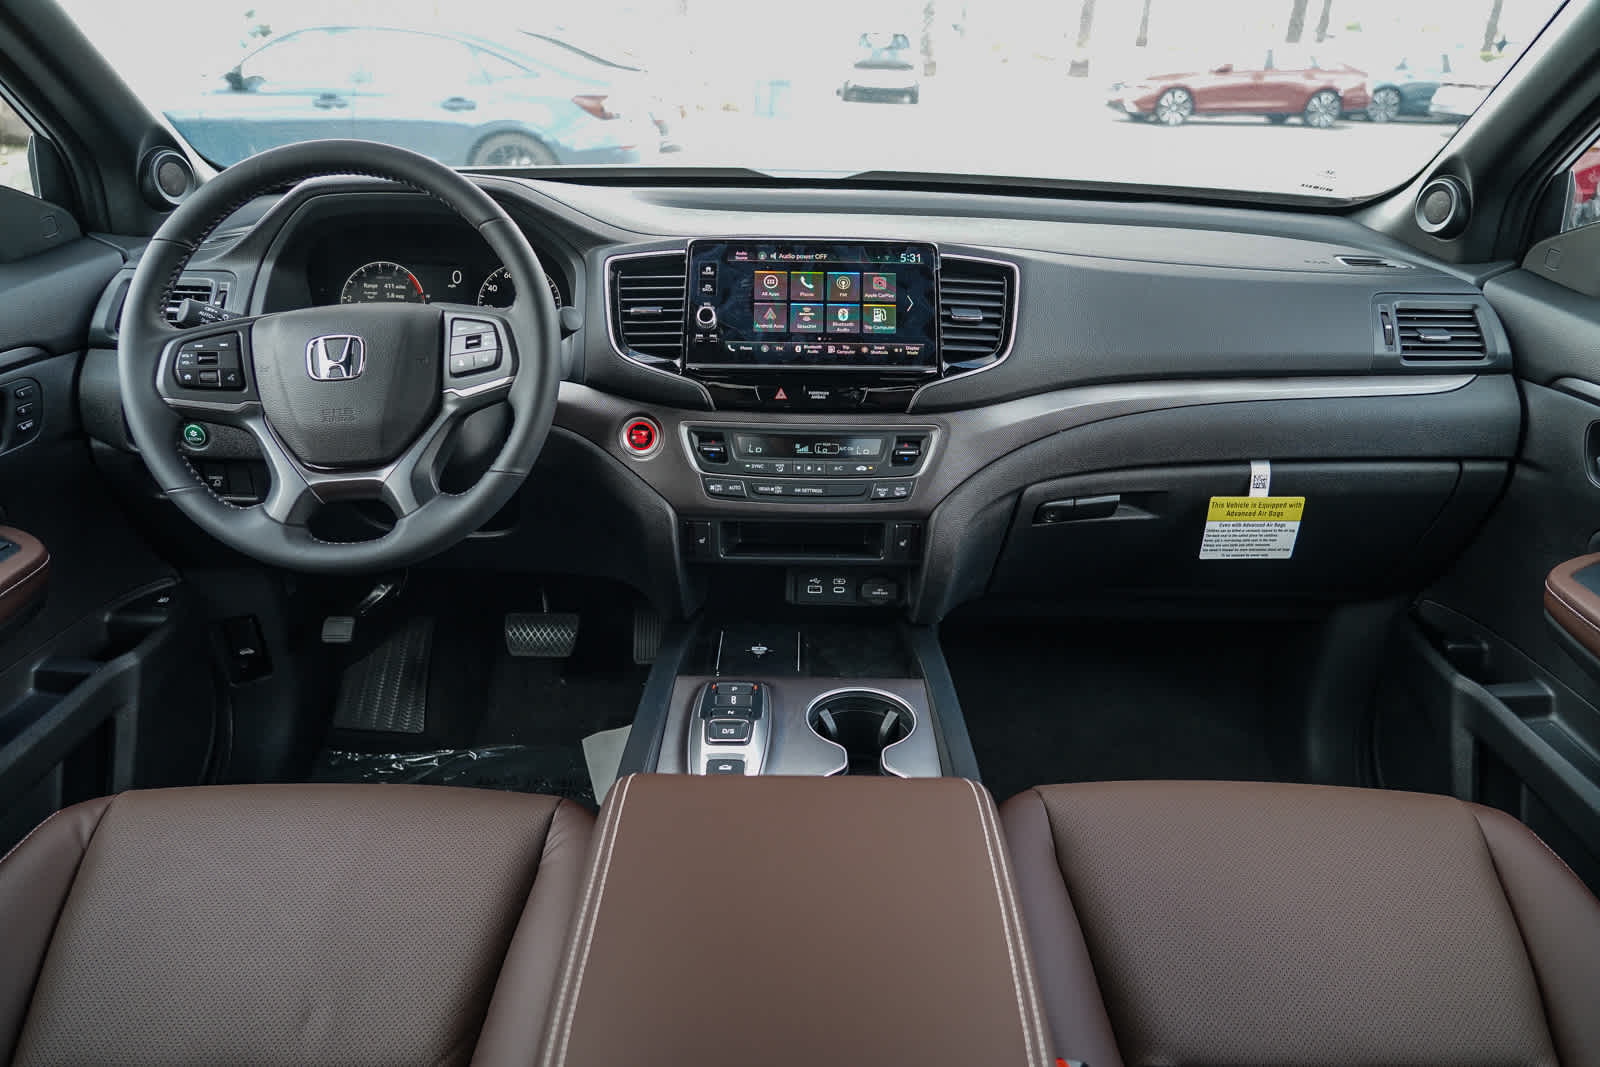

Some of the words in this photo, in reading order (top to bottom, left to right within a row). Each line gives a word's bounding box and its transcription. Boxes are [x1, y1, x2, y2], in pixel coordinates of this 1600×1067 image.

[900, 253, 921, 263] 5:31
[452, 270, 462, 284] 0
[748, 444, 762, 453] Lo
[856, 446, 869, 455] Lo
